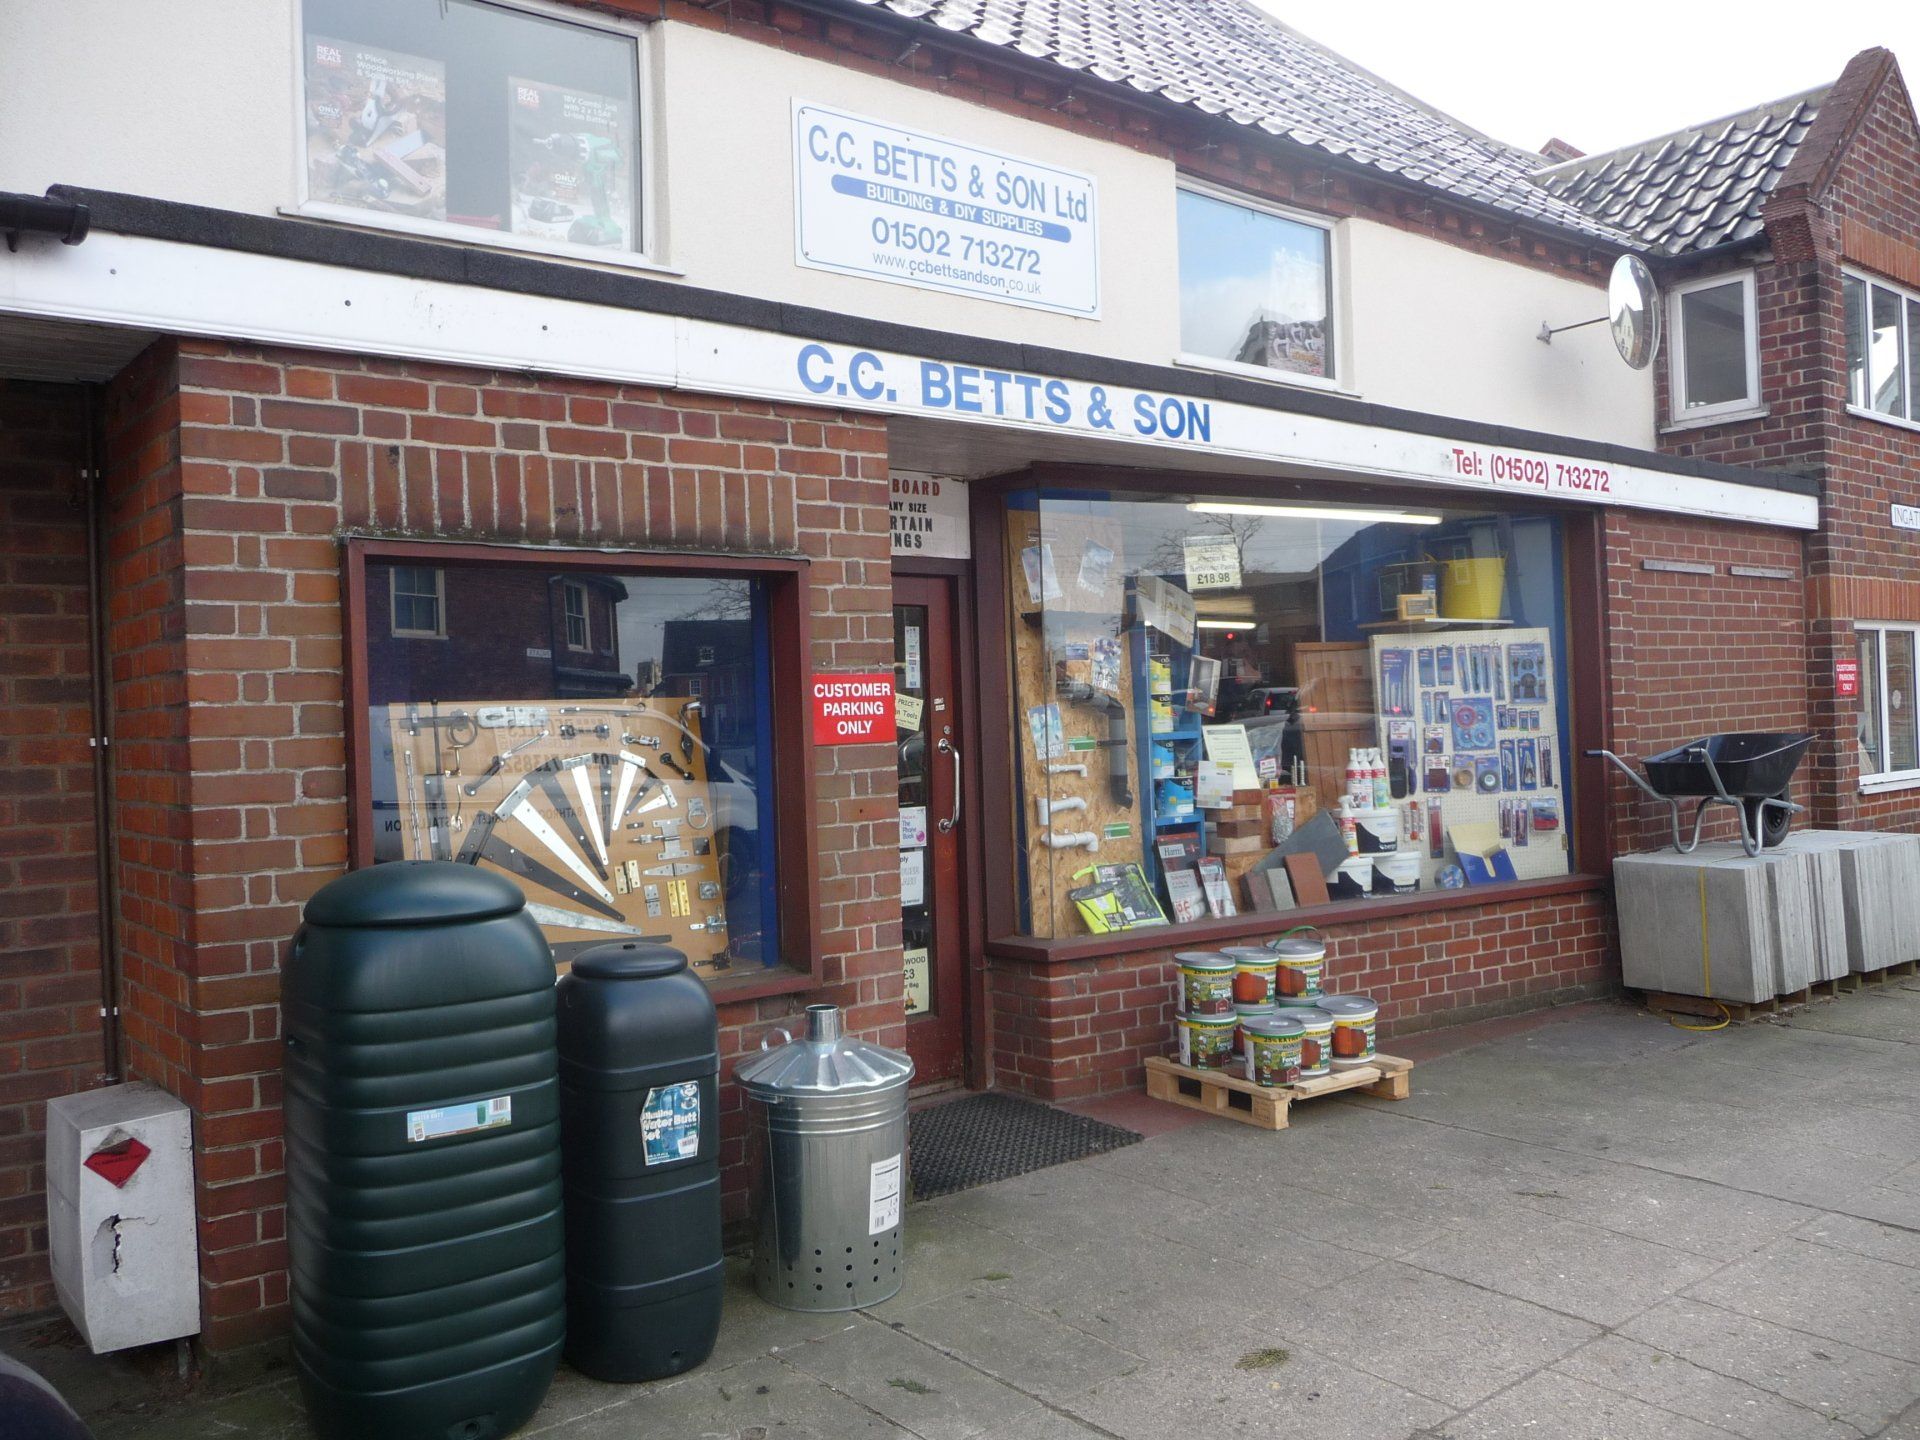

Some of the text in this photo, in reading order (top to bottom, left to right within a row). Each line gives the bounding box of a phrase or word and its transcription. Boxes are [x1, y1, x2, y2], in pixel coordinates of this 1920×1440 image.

[316, 45, 341, 56] REAL
[316, 53, 341, 64] DEALS
[356, 61, 415, 80] Woodworking
[518, 87, 538, 97] REAL
[318, 104, 339, 115] ONLY
[555, 173, 577, 183] ONLY
[808, 125, 1088, 223] C.C. BETTS & SON Ltd
[866, 183, 1044, 236] BUILDING & DIY SUPPLIES
[872, 217, 1041, 275] 01502 713272
[872, 252, 1042, 294] www.ccbettsandson.co.uk
[797, 344, 1211, 442] C.C. BETTS & SON
[1452, 448, 1610, 492] Tel: (01502) 713272
[892, 479, 940, 496] BOARD
[909, 502, 927, 513] SIZE
[1894, 506, 1920, 527] INGAT
[1197, 572, 1230, 584] £18.98
[814, 682, 891, 698] CUSTOMER
[823, 702, 884, 716] PARKING
[898, 698, 915, 707] PRICE
[903, 709, 918, 720] Tools
[837, 720, 872, 735] ONLY
[674, 1111, 698, 1126] Butt
